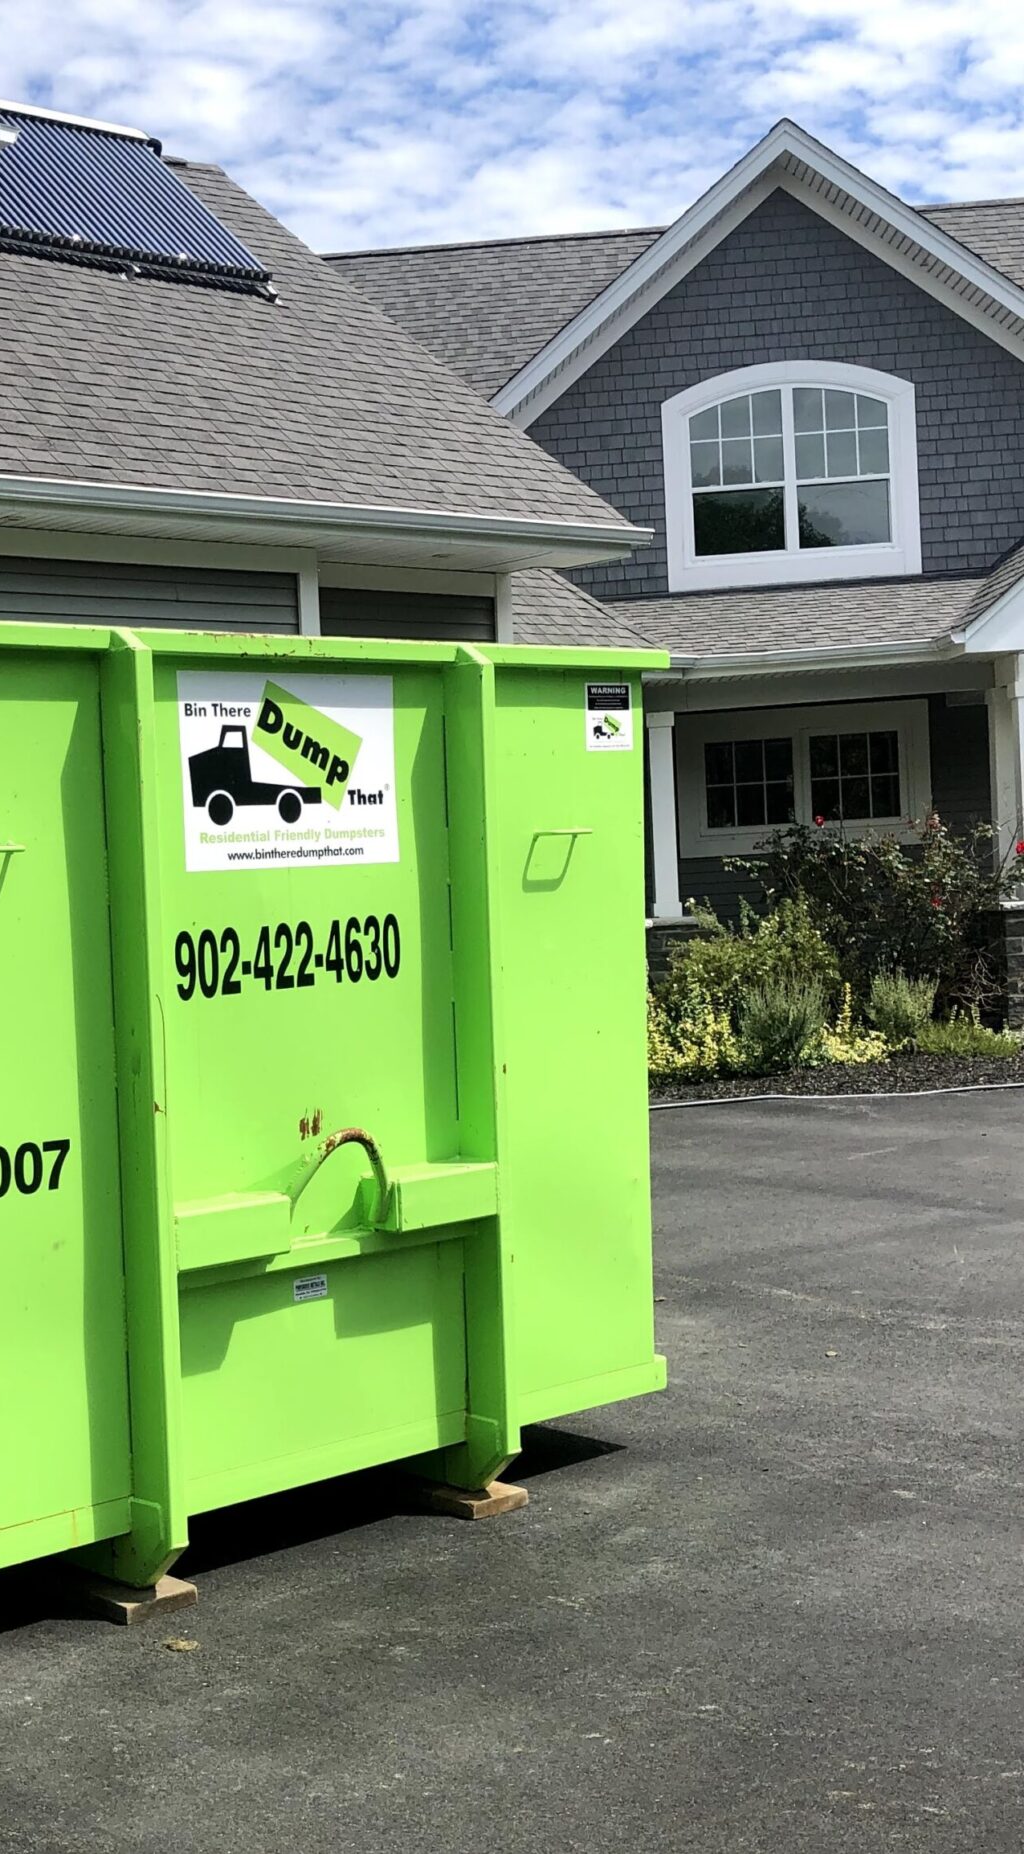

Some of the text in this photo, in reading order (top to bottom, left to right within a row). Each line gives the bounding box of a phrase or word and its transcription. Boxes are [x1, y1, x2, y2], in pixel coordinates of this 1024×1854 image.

[184, 703, 251, 717] Bin There
[257, 697, 349, 786] Dump
[347, 789, 384, 805] That
[199, 827, 385, 844] Residential Friendly Dumpsters
[227, 846, 364, 861] www.bintheredumpthat.com
[175, 913, 401, 1001] 902-422-4630
